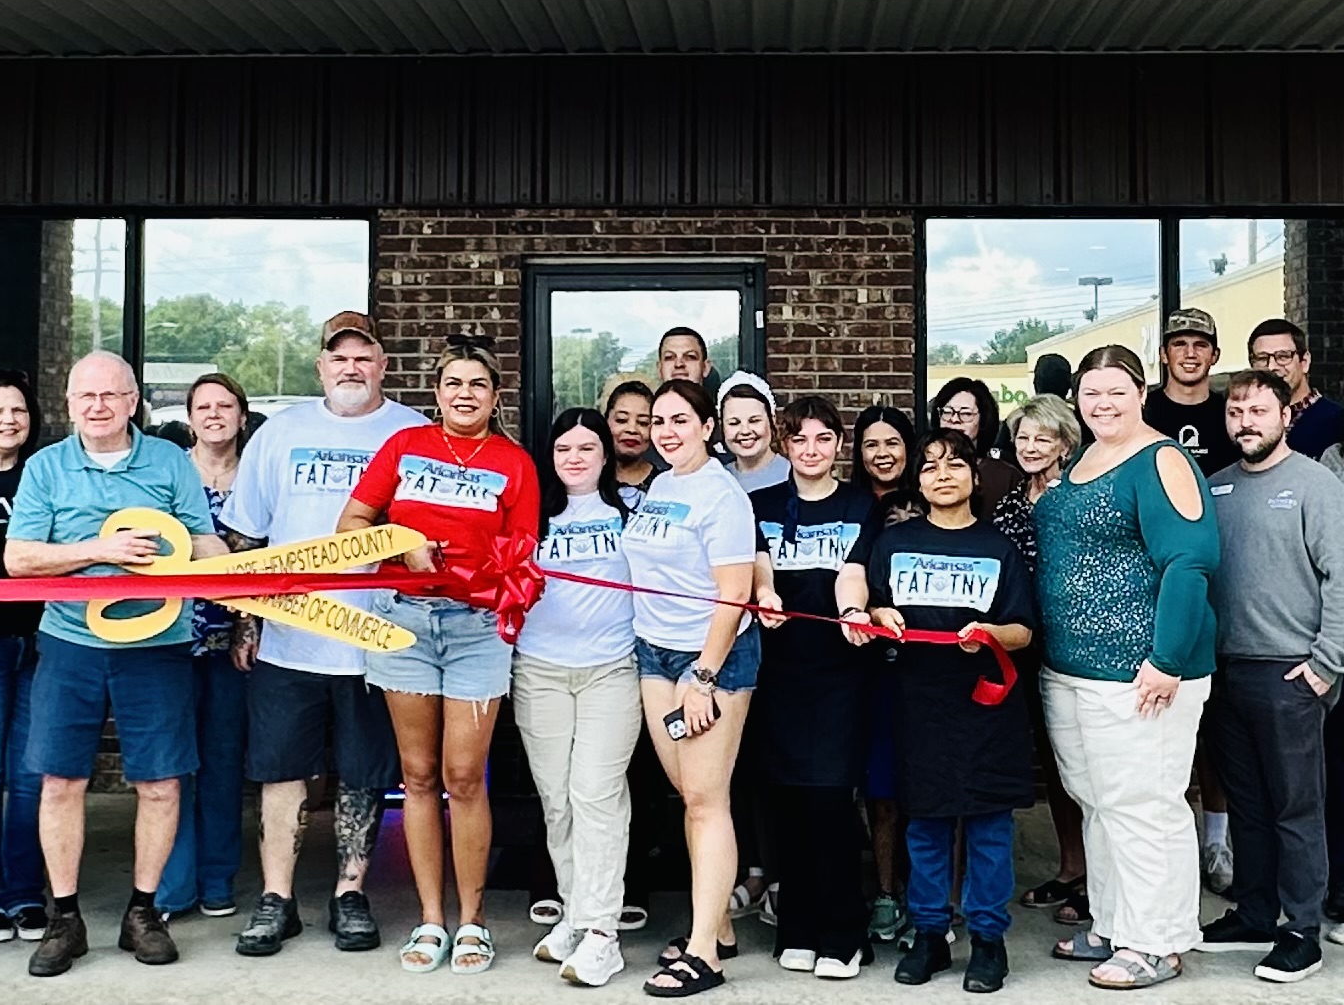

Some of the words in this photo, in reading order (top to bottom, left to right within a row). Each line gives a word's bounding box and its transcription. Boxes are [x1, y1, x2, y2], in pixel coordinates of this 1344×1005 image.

[294, 463, 332, 486] FAT
[403, 469, 441, 493] FAT
[342, 527, 394, 561] COUNTY
[537, 537, 574, 561] FAT
[589, 530, 622, 554] TN
[897, 571, 934, 595] FAT
[951, 573, 989, 599] TNY
[308, 598, 325, 624] OF
[325, 604, 396, 650] COMMERCE
